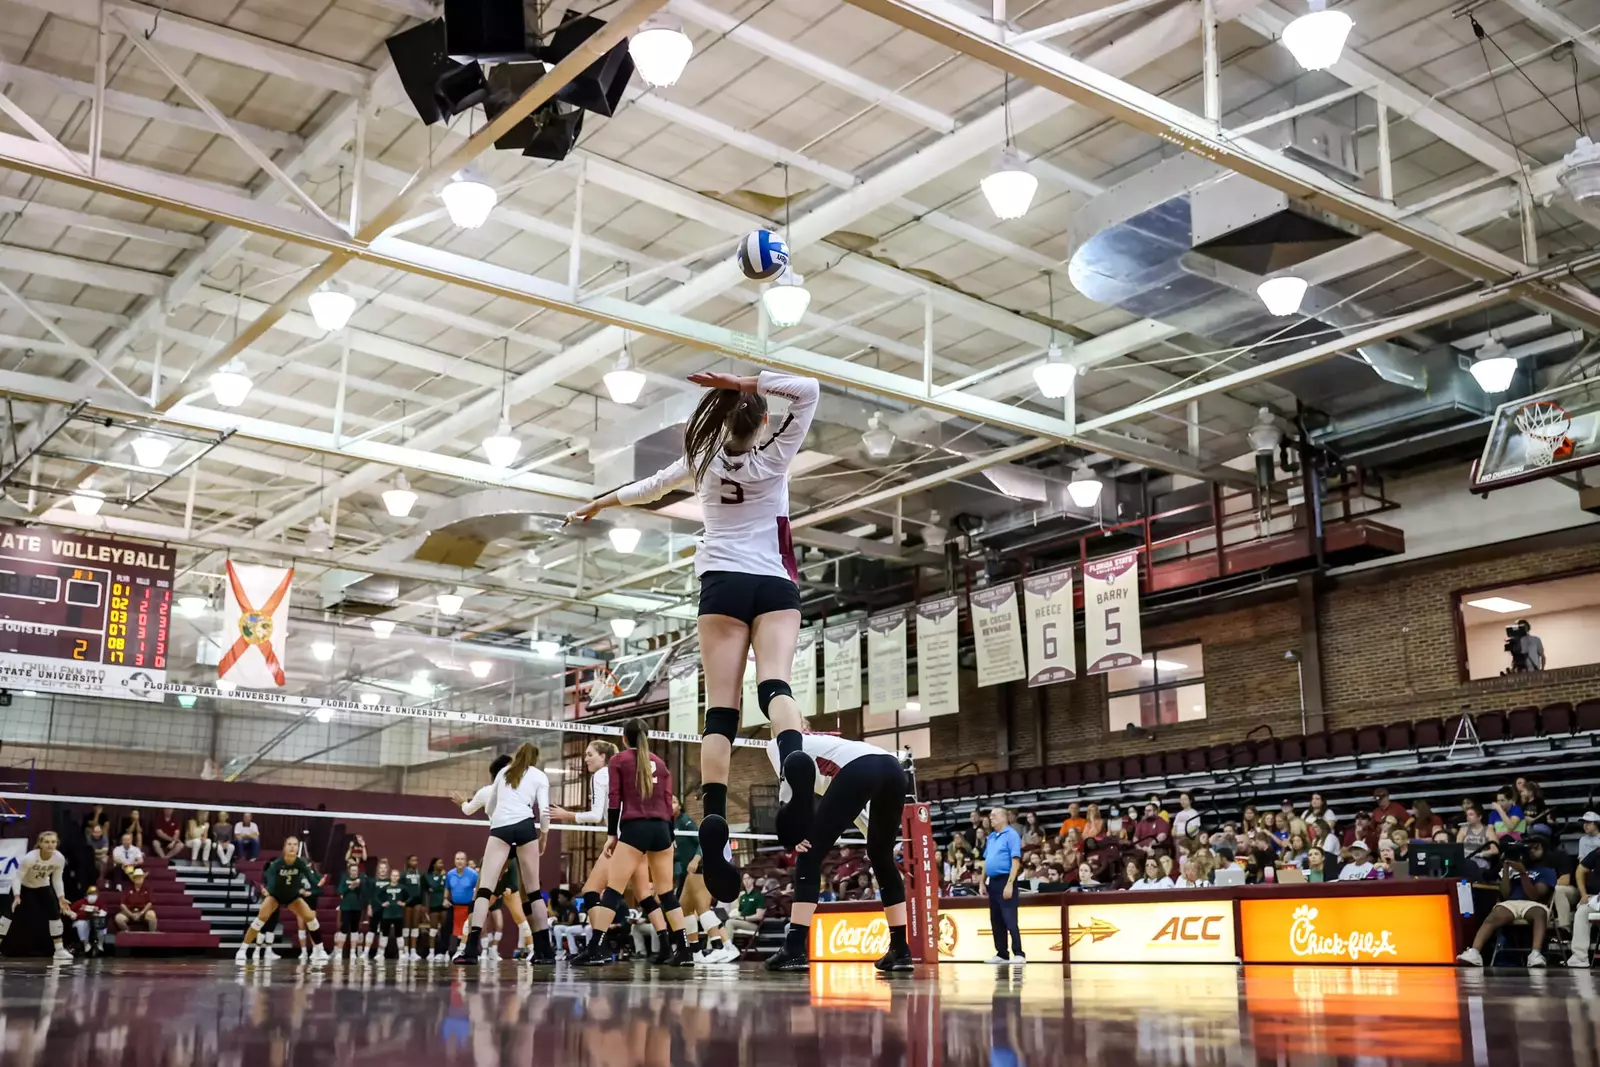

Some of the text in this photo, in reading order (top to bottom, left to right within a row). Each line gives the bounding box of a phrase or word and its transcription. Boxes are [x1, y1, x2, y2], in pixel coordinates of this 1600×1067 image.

[720, 478, 744, 504] 3
[0, 533, 171, 570] ATE VOLLEYBALL
[1089, 556, 1132, 572] FLORIDA STATE
[113, 583, 170, 601] 01 1 1
[1097, 588, 1128, 604] BARRY
[112, 597, 168, 614] 02 2 2
[1035, 604, 1062, 618] REECE
[110, 610, 167, 628] 03 0 3
[1105, 607, 1121, 646] 5
[6, 624, 33, 633] OUTS
[35, 627, 58, 636] LEFT
[109, 623, 166, 641] 07 3 3
[73, 639, 88, 659] 2
[108, 637, 165, 654] 08 1 3
[1043, 623, 1057, 659] 6
[110, 651, 165, 668] 17 3 0
[38, 671, 104, 684] UNIVERSITY
[144, 682, 286, 702] FLORIDA STATE UNIVERSITY
[321, 700, 359, 709] FLORIDA
[396, 707, 448, 718] UNIVERSITY
[478, 715, 592, 731] FLORIDA STATE UNIVERSITY
[286, 876, 292, 885] 2
[922, 835, 934, 948] SEMINOLES
[829, 919, 891, 954] Coca-Col
[1152, 915, 1225, 941] ACC
[1290, 908, 1397, 959] Chick-fil-A
